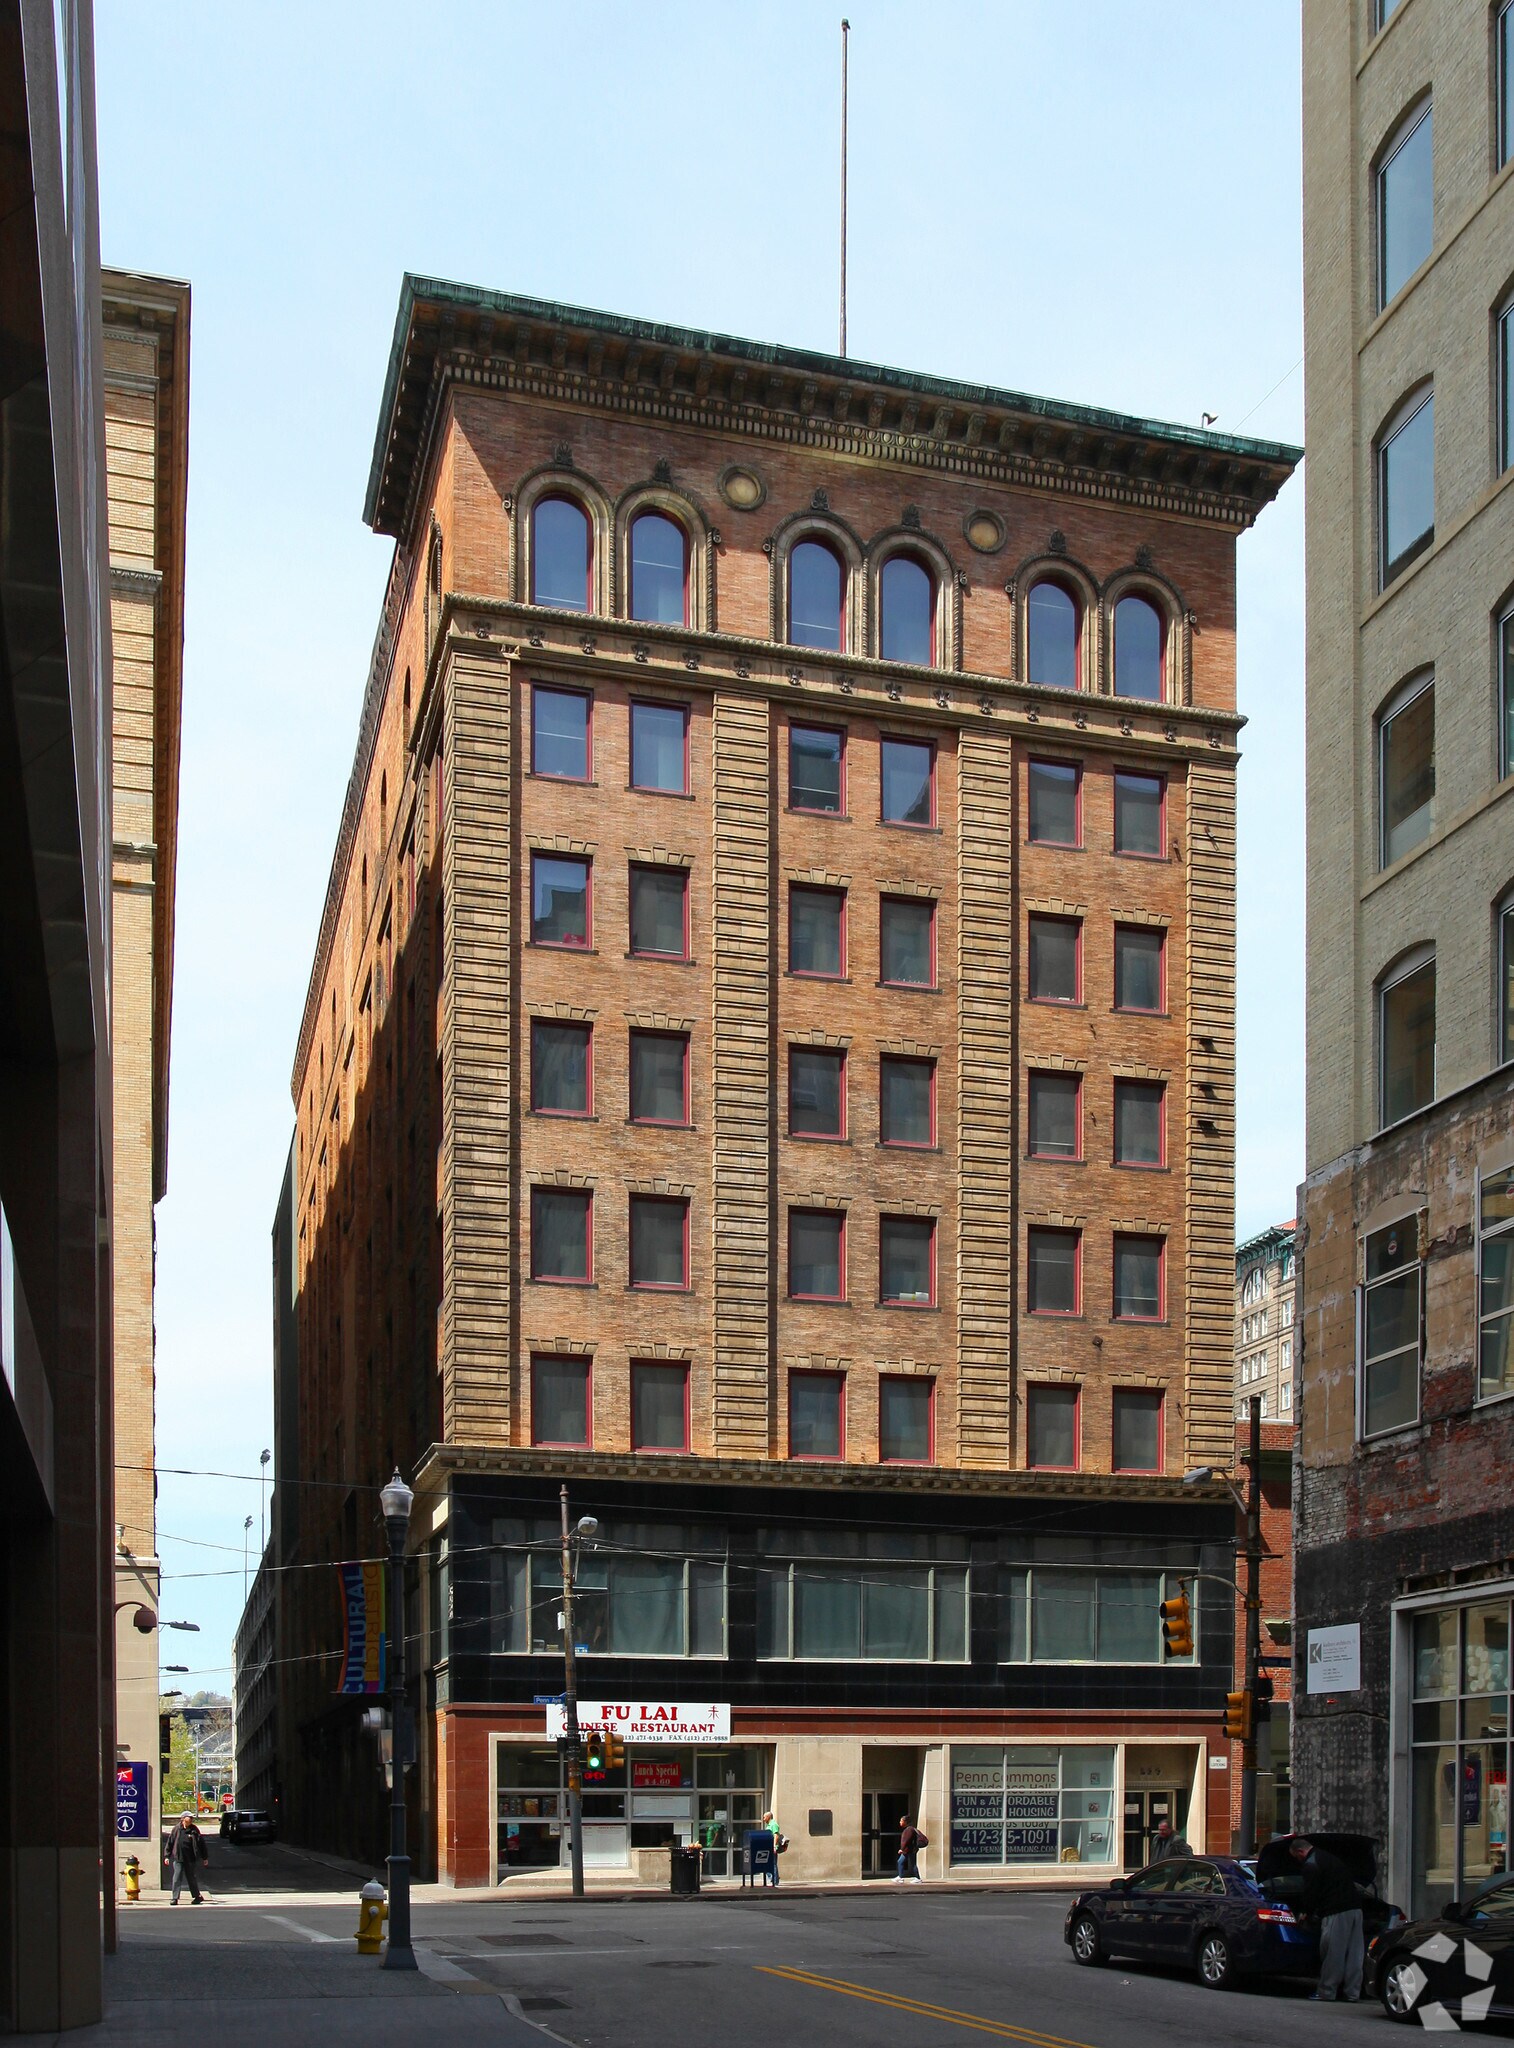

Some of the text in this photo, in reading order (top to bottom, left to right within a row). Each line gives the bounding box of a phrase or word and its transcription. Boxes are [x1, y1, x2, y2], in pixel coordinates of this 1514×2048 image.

[342, 1565, 367, 1693] CULTURAL
[601, 1705, 678, 1721] FU LAI
[561, 1722, 716, 1733] CINESE RESTAURANT
[584, 1771, 606, 1780] OPEN
[634, 1764, 679, 1778] Lunch Special
[956, 1771, 989, 1783] Penn
[117, 1787, 138, 1797] LO
[1029, 1783, 1052, 1794] Hall
[117, 1800, 138, 1809] cademy
[956, 1796, 1056, 1806] FUN & AFORDABLE
[957, 1807, 1055, 1817] STUDENT HOUSING
